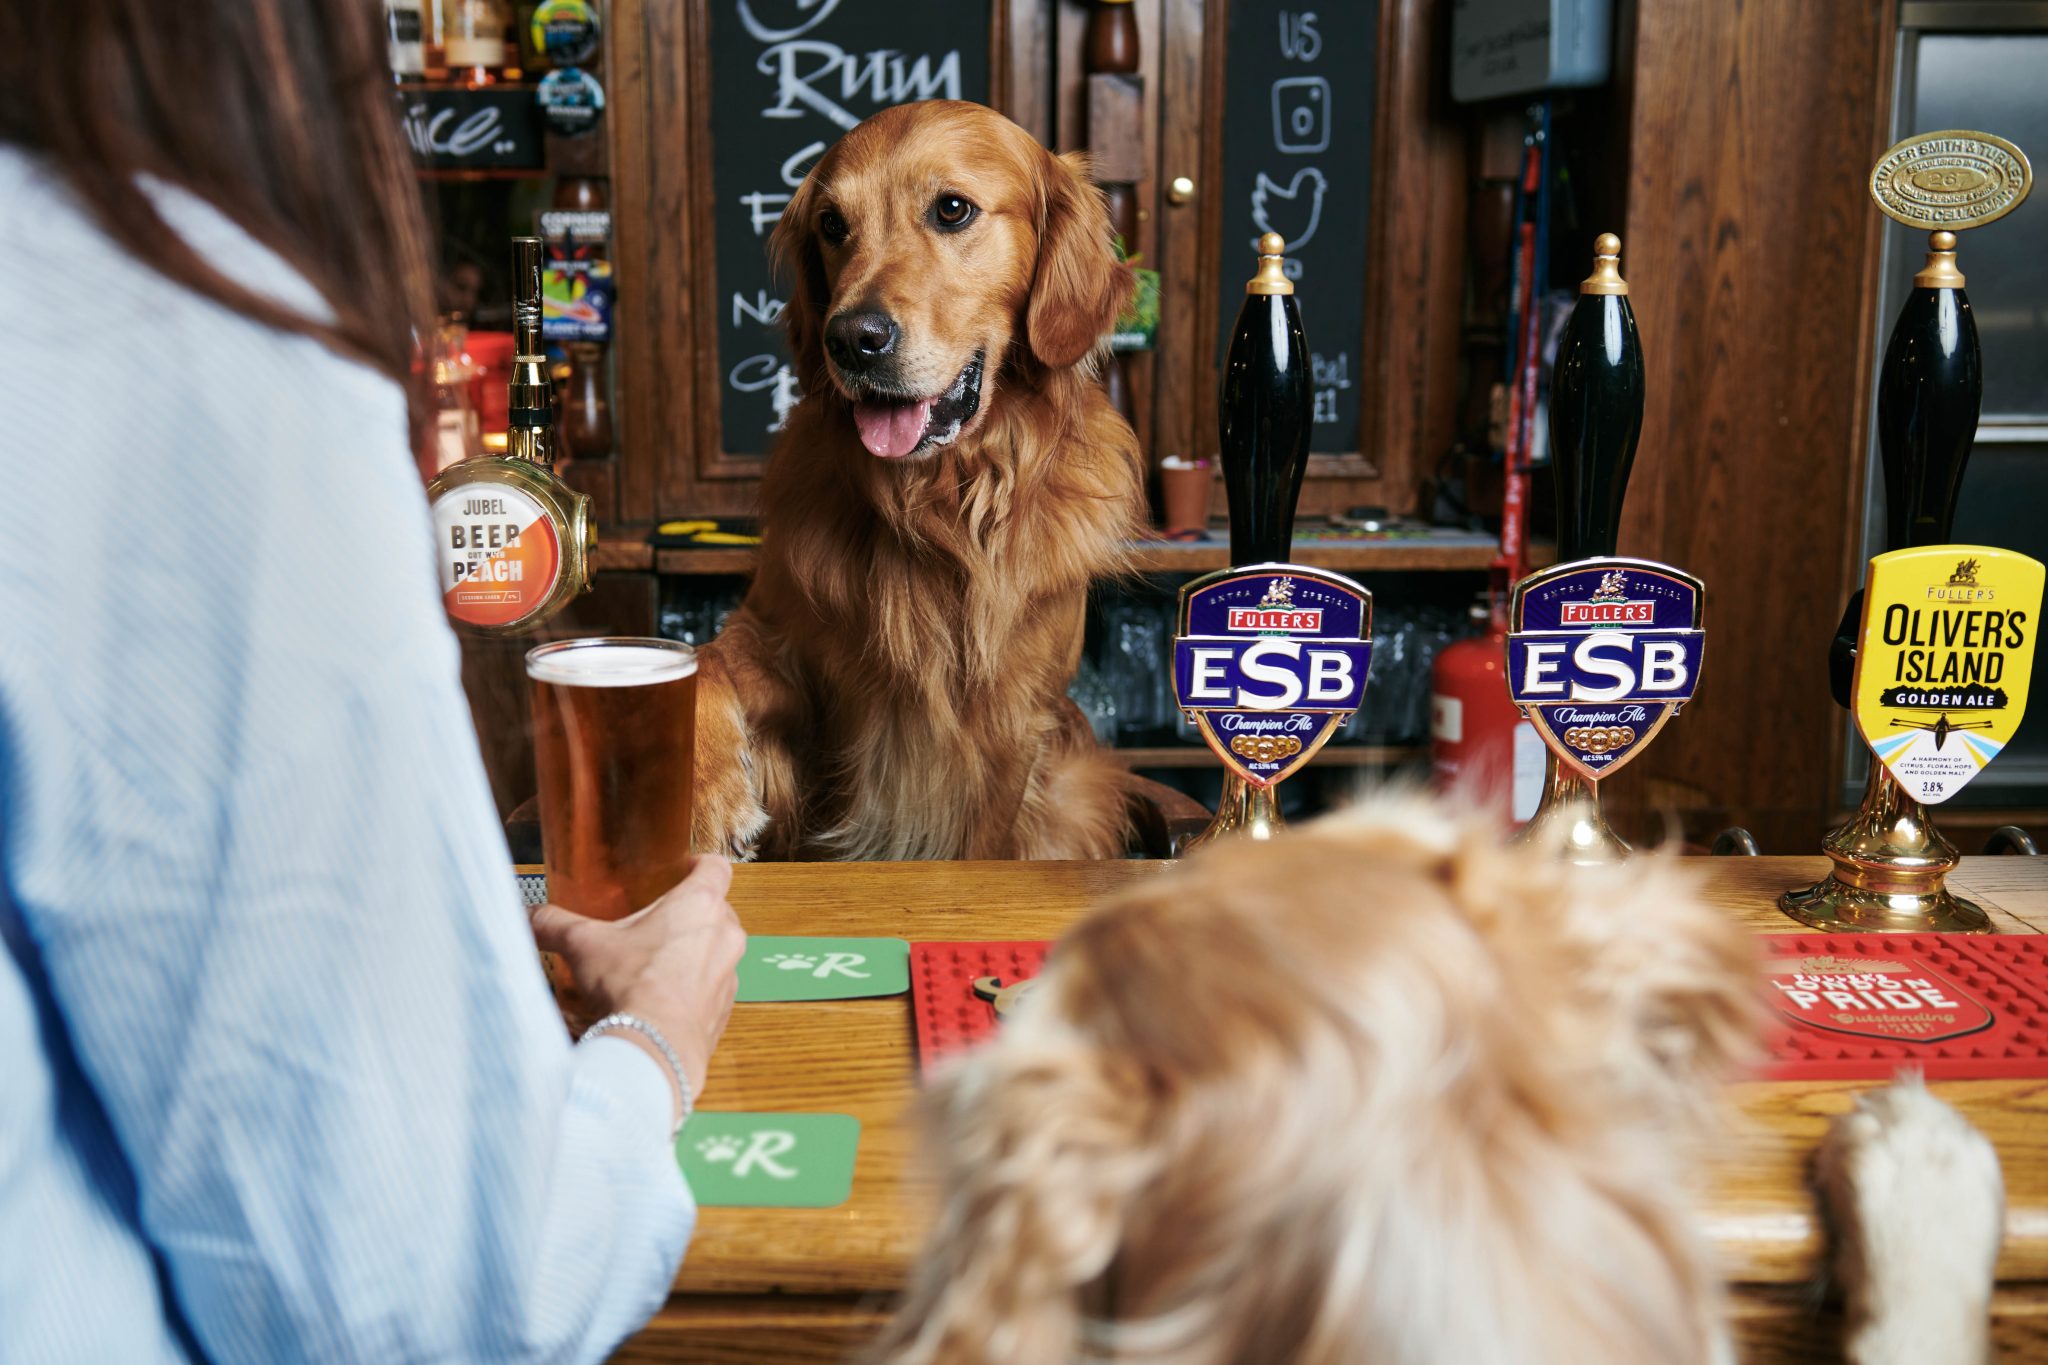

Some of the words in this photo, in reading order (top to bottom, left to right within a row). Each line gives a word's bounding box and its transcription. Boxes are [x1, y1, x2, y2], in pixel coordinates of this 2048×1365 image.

[1279, 11, 1322, 62] US
[757, 39, 961, 131] Rum
[1919, 141, 1964, 155] SMITH
[1967, 142, 1976, 153] &
[1980, 143, 2021, 189] TURNER
[463, 499, 506, 515] JUBEL
[451, 524, 520, 548] BEER
[453, 560, 522, 582] PEACH
[1927, 587, 1995, 600] FULLER'S
[1235, 611, 1315, 628] FULLER'S
[1568, 605, 1647, 620] FULLER'S
[1883, 604, 2026, 649] OLIVER'S
[1187, 639, 1355, 710] ESB
[1520, 633, 1688, 701] ESB
[1896, 650, 2004, 683] ISLAND
[1896, 693, 1961, 706] GOLDEN
[1966, 695, 1994, 706] ALE
[1220, 714, 1283, 736] Champion
[1284, 714, 1313, 732] Ale
[1554, 707, 1616, 728] Champion
[1618, 705, 1646, 723] Ale
[1923, 782, 1943, 792] 3.8%
[1772, 978, 1932, 990] LONDON
[1785, 989, 1960, 1010] PRIDE
[1830, 1012, 1956, 1024] Outstanding
